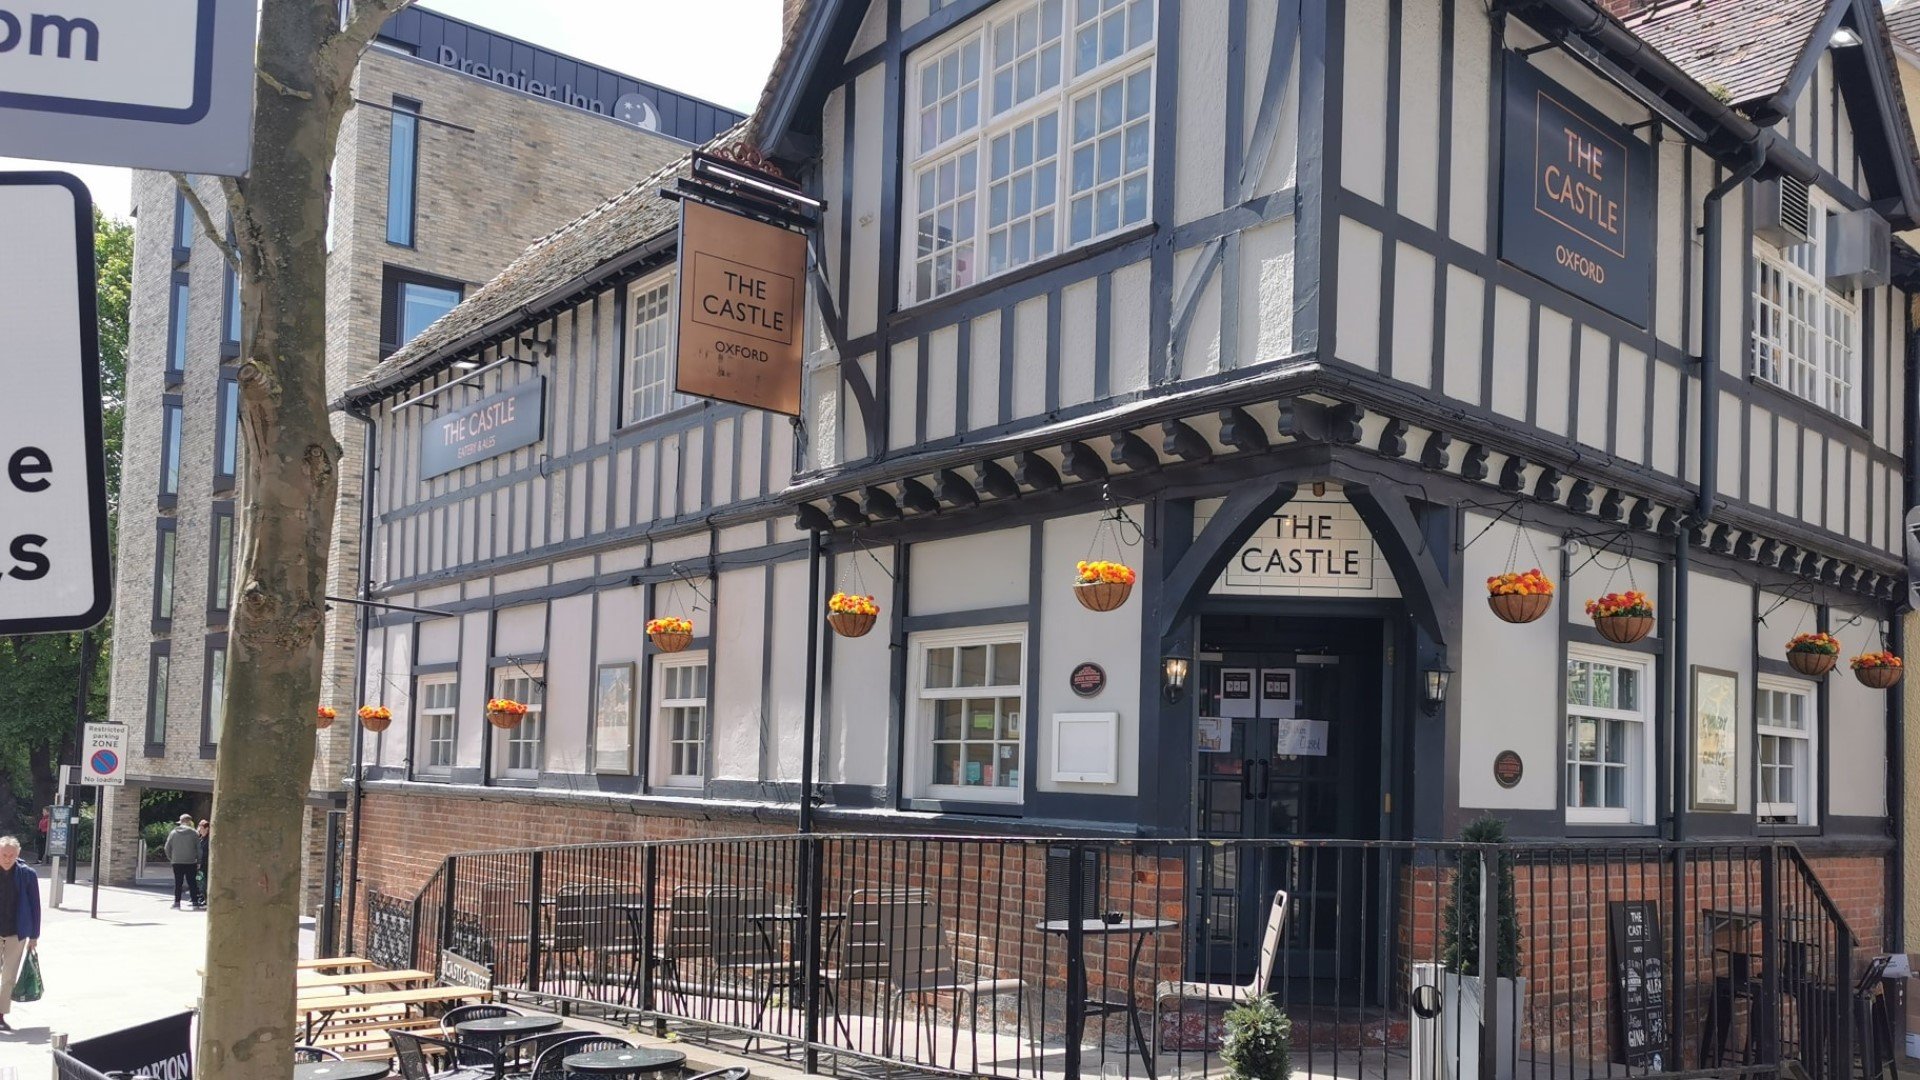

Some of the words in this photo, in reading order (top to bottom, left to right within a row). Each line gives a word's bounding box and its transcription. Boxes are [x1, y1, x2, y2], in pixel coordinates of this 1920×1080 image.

[438, 44, 556, 100] Premier
[1564, 127, 1603, 181] THE
[1544, 164, 1618, 234] CASTLE
[1555, 244, 1605, 284] OXFORD
[724, 270, 766, 300] THE
[703, 294, 784, 332] CASTLE
[715, 340, 769, 363] OXFORD
[443, 416, 466, 447] THE
[469, 397, 516, 437] CASTLE
[1269, 515, 1332, 539] THE
[0, 533, 51, 581] s
[1241, 547, 1359, 575] CASTLE
[92, 740, 119, 748] ZONE
[97, 776, 122, 784] loading
[1627, 924, 1649, 936] CASTE
[1630, 912, 1643, 923] THE
[446, 960, 468, 984] CASTLE
[468, 970, 491, 991] STREET
